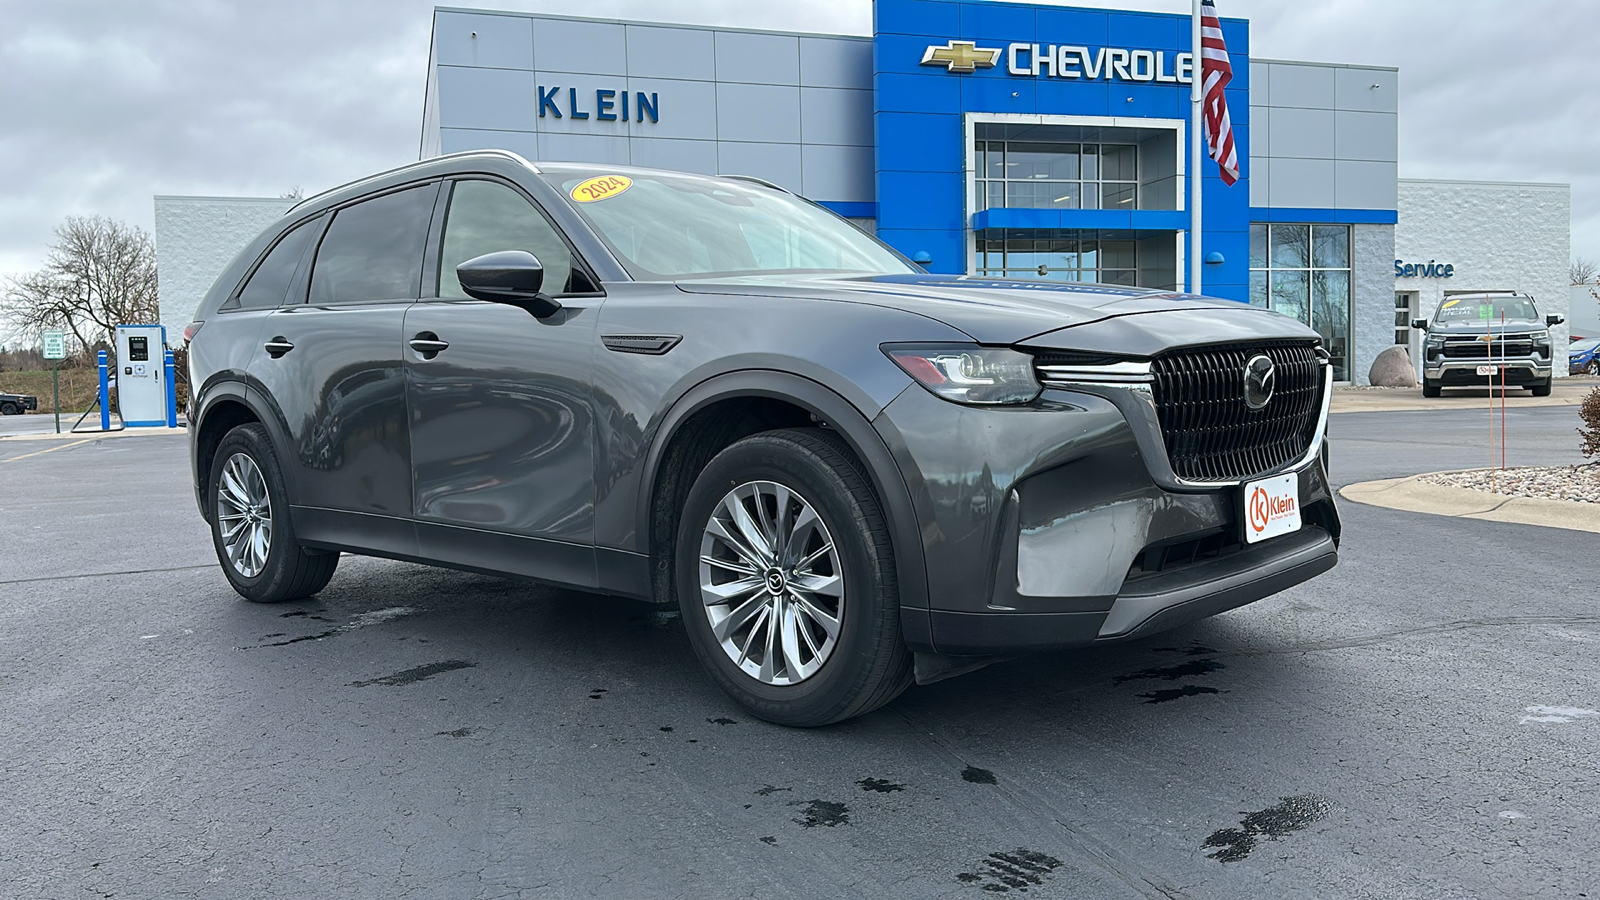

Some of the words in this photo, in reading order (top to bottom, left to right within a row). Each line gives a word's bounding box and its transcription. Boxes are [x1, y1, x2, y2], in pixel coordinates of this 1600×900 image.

[1008, 43, 1193, 83] CHEVROLE
[538, 86, 659, 123] KLEIN
[581, 176, 626, 199] 2024
[1394, 259, 1454, 278] Service
[1270, 494, 1295, 516] Klein
